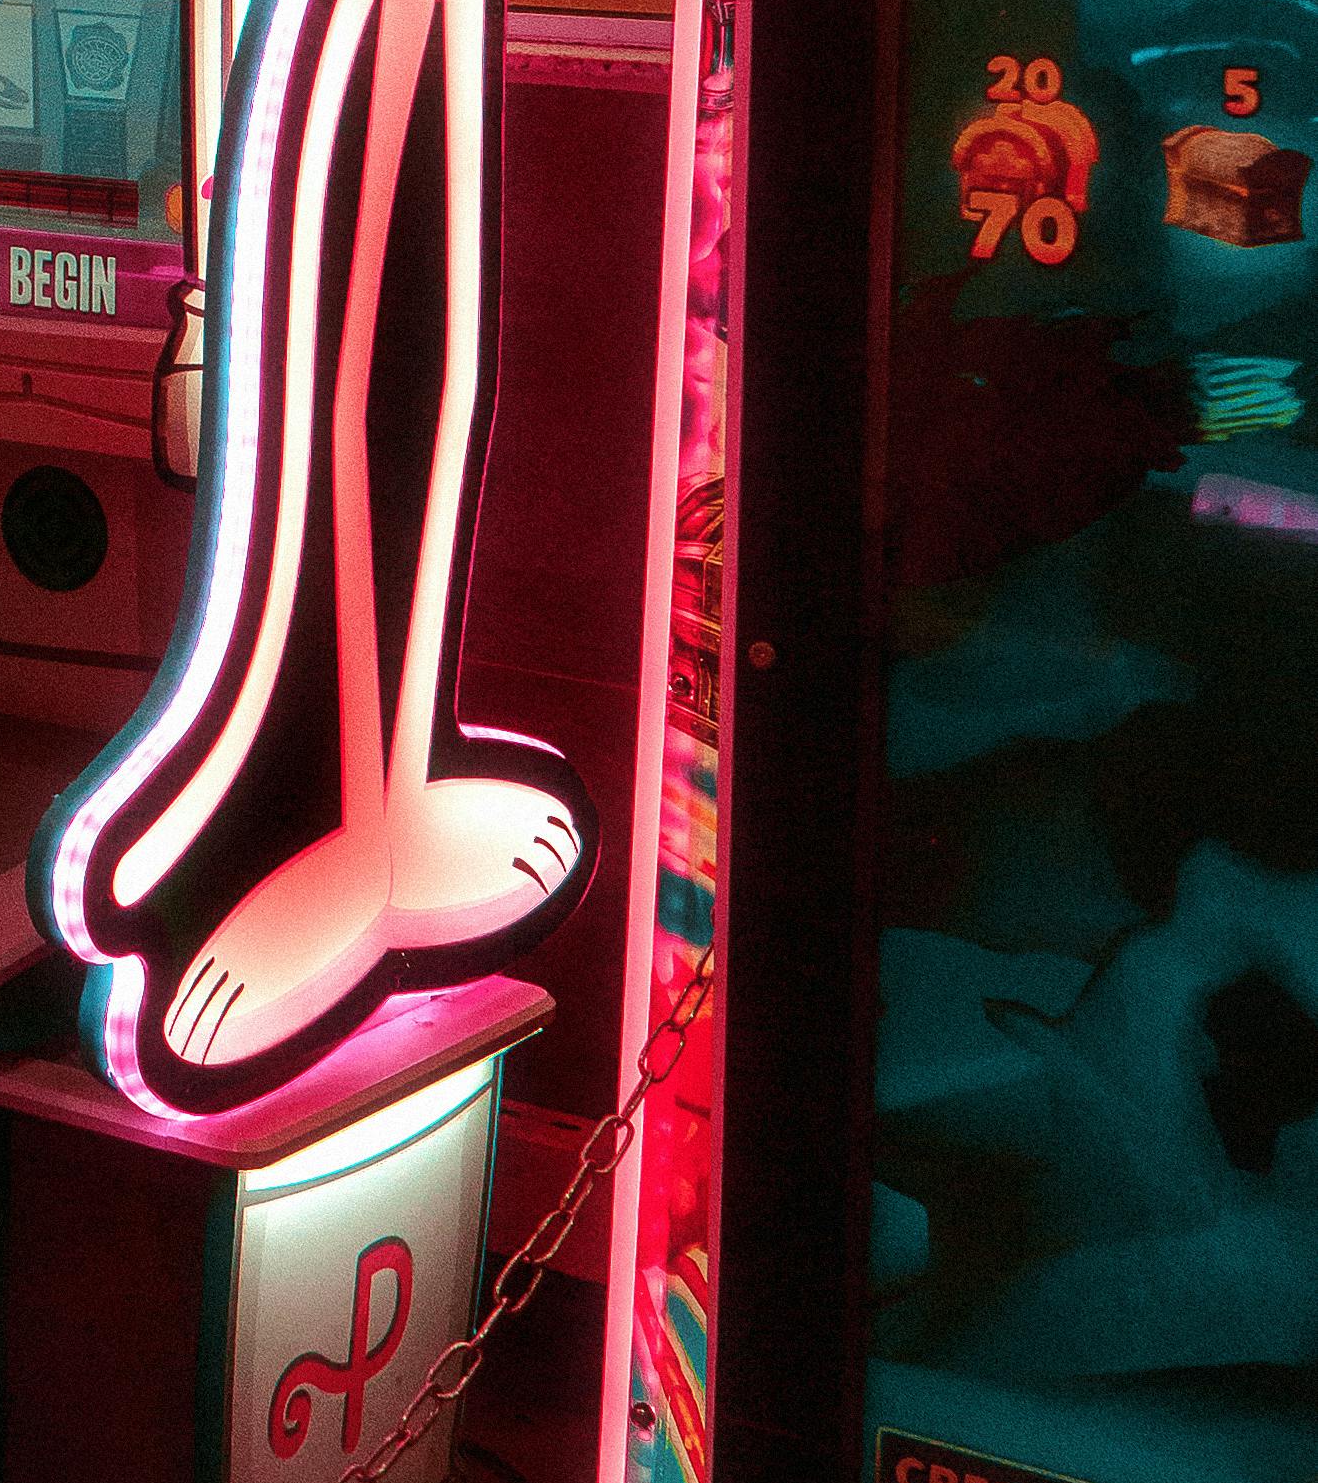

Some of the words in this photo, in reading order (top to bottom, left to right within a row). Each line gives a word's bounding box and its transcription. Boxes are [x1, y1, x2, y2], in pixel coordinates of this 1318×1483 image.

[987, 56, 1061, 103] 20
[1224, 68, 1258, 115] 5
[969, 191, 1079, 264] 70
[11, 250, 117, 315] BEGIN
